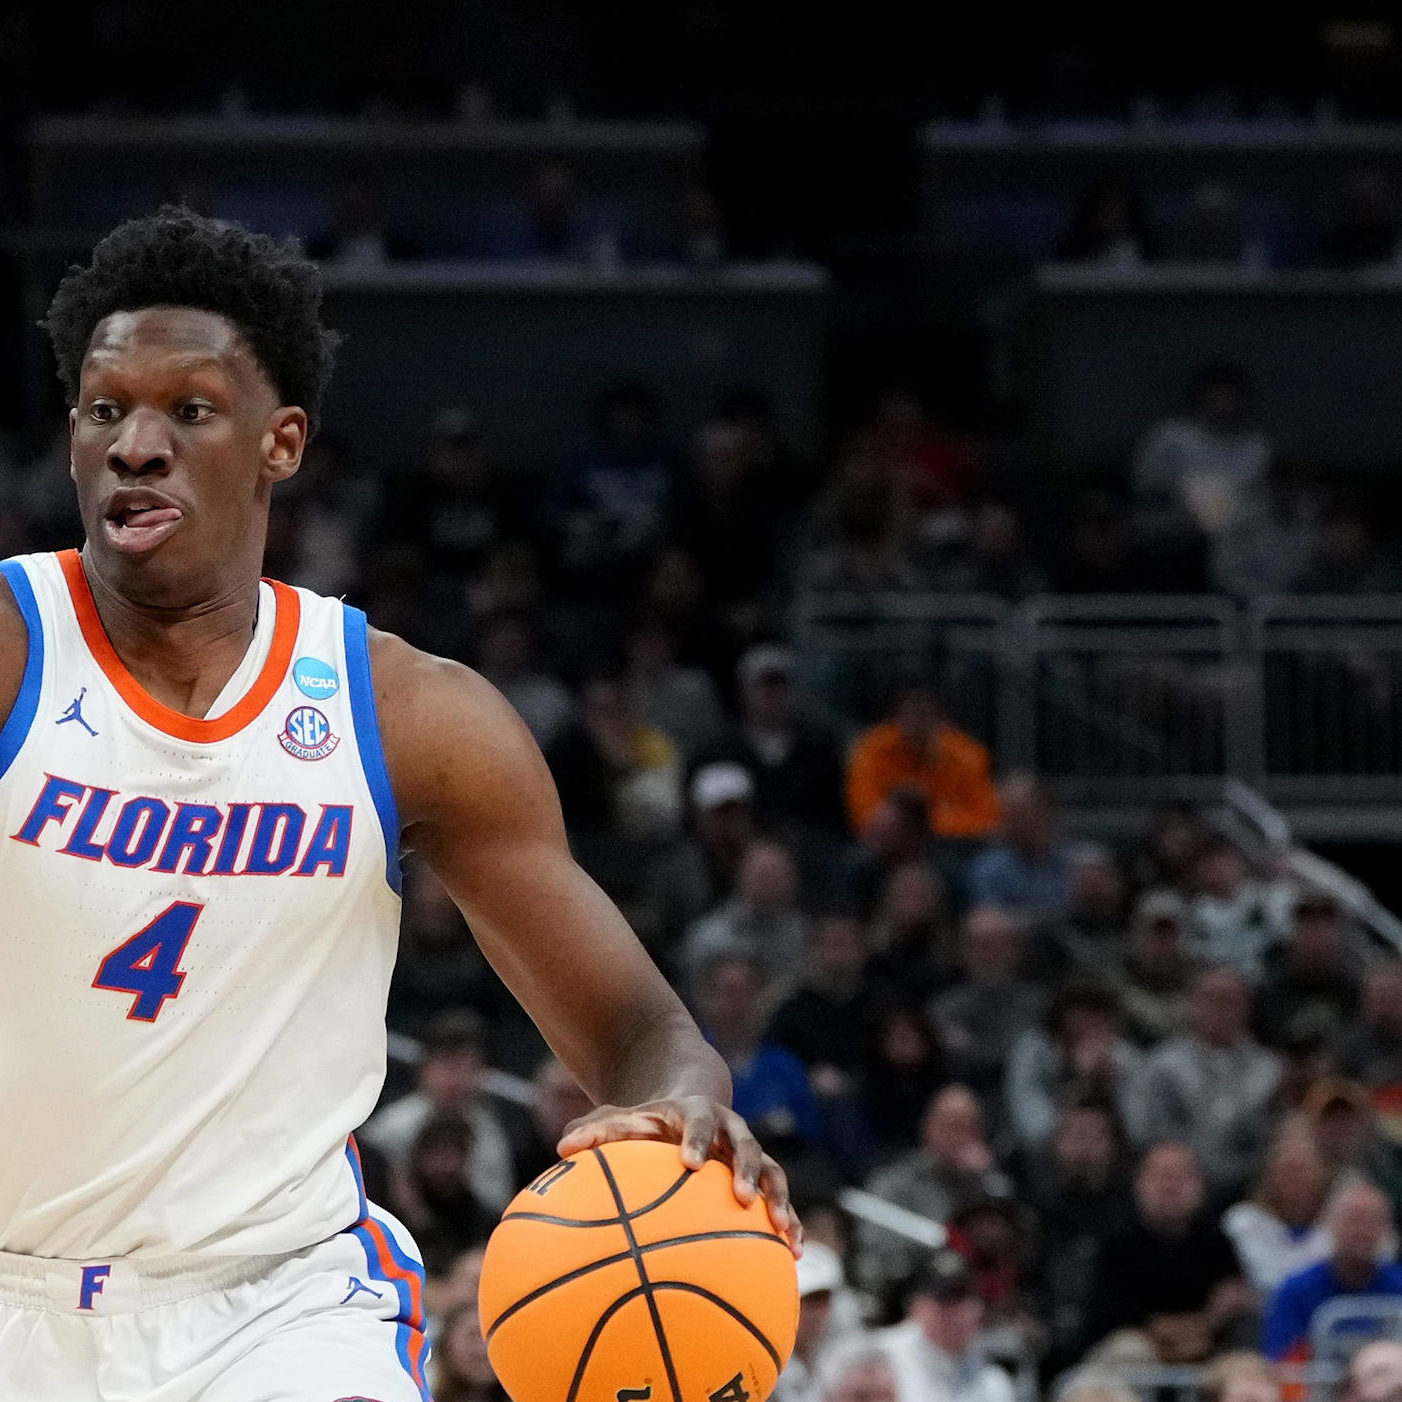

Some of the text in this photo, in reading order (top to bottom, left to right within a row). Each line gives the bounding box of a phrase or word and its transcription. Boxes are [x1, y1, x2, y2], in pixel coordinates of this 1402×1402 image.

[299, 675, 337, 690] NCAA
[289, 708, 327, 747] SEC
[285, 740, 333, 759] GRADUATE
[9, 771, 354, 877] FLORIDA
[91, 900, 205, 1023] 4
[76, 1264, 112, 1311] F
